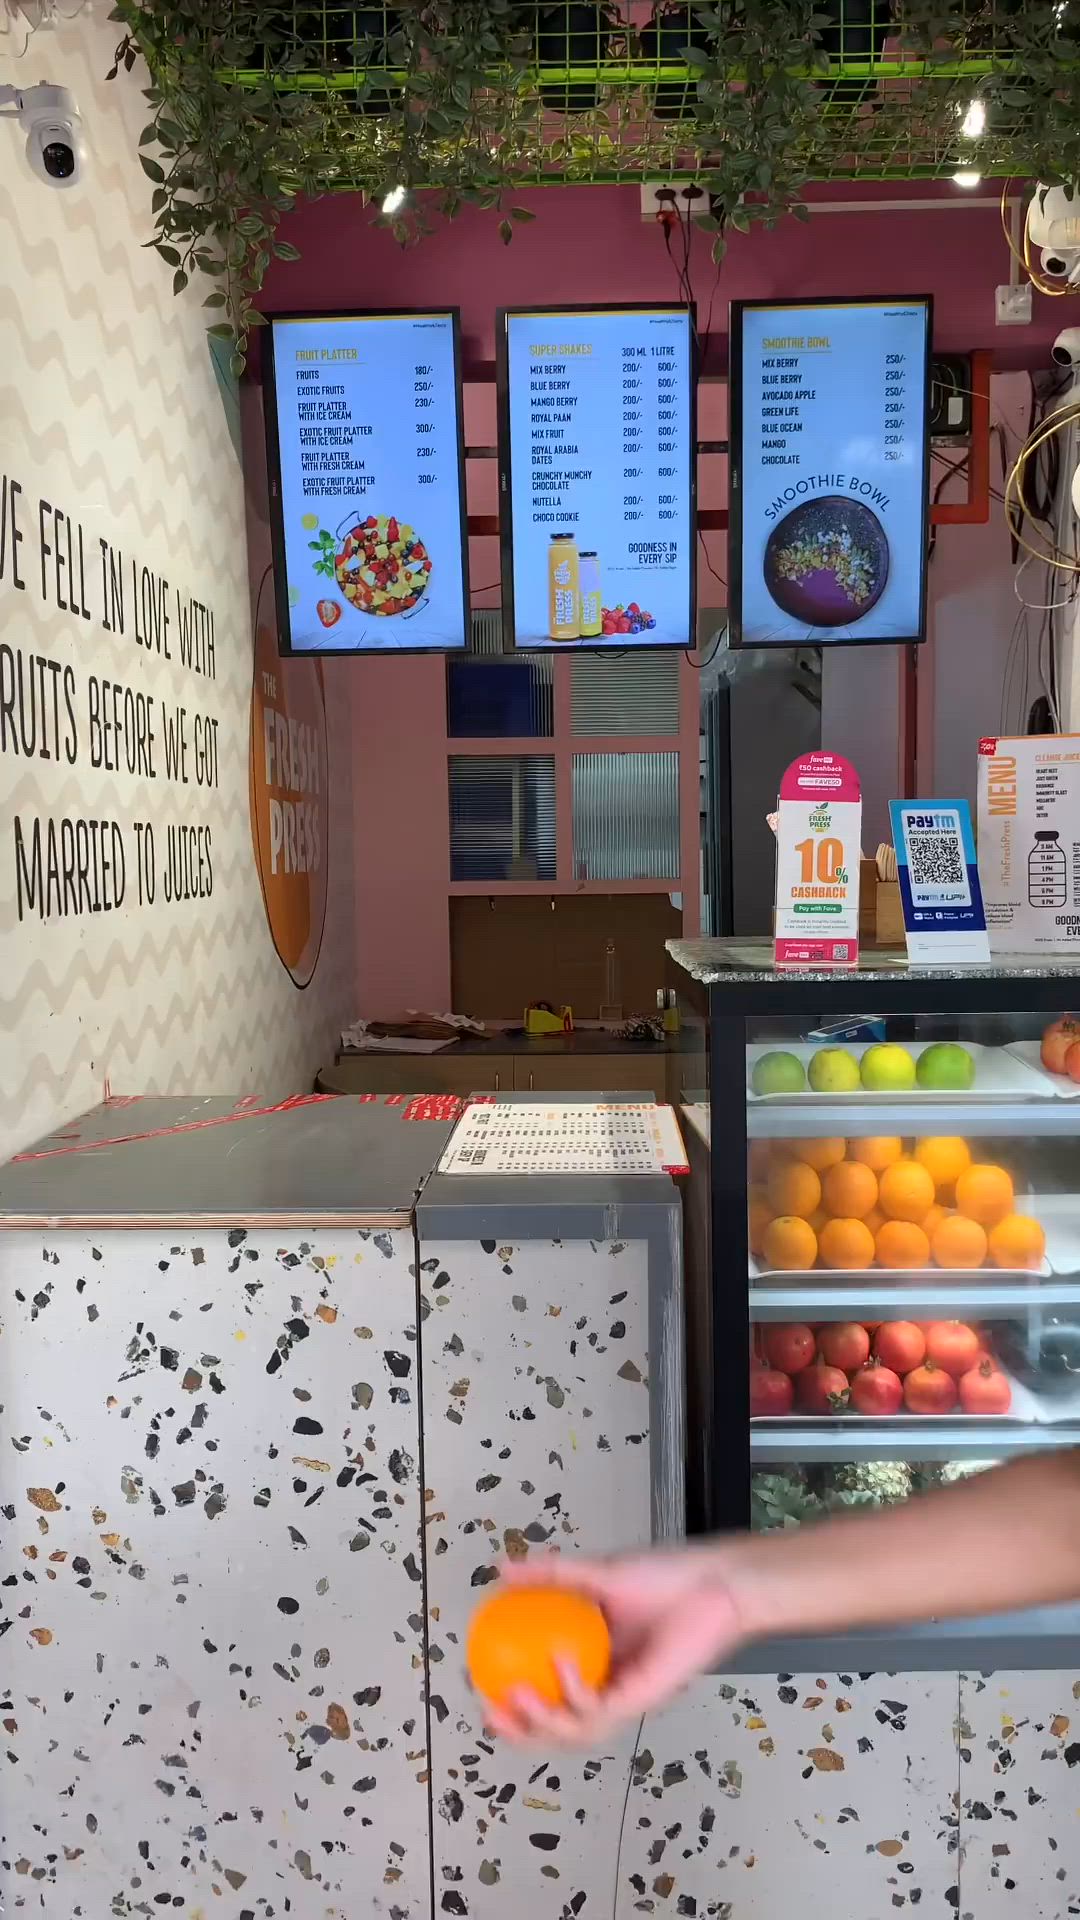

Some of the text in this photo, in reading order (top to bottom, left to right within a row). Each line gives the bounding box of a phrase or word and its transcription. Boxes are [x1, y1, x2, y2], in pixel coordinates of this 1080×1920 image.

[762, 337, 830, 349] SMOOTHIE BOWL
[529, 344, 592, 356] SUPER SHAKES
[622, 347, 647, 356] 300 ML
[652, 347, 675, 356] 1 LITRE
[296, 349, 357, 361] FRUIT PLATTER
[885, 355, 906, 364] 250/-
[623, 364, 642, 372] 200/-
[658, 363, 677, 371] 600/-
[762, 359, 798, 368] MIX BERRY
[415, 366, 433, 375] 180/-
[530, 365, 566, 375] MIX BERRY
[296, 371, 319, 379] FRUITS
[762, 375, 802, 384] BLUE BERRY
[885, 371, 905, 380] 250/-
[414, 383, 433, 391] 250/-
[531, 381, 570, 390] BLUE BERRY
[623, 380, 642, 388] 200/-
[658, 379, 677, 387] 600/-
[297, 386, 344, 396] EXOTIC FRUITS
[885, 388, 905, 396] 250/-
[623, 396, 642, 405] 200/-
[658, 395, 677, 404] 600/-
[762, 391, 815, 401] AVOCADO APPLE
[415, 398, 435, 407] 230/-
[531, 397, 578, 406] MANGO BERRY
[298, 402, 346, 412] FRUIT PLATTER
[885, 404, 905, 413] 250/-
[299, 411, 351, 421] WITH ICE CREAM
[623, 412, 643, 421] 200/-
[658, 411, 677, 420] 600/-
[762, 407, 799, 417] GREEN LIFE
[531, 413, 571, 423] ROYAL PAAN
[416, 424, 435, 433] 300/-
[762, 423, 802, 433] BLUE OCEAN
[885, 420, 905, 429] 250/-
[300, 426, 372, 437] EXOTIC FRUIT PLATTER
[532, 429, 564, 439] MIX FRUIT
[623, 428, 643, 437] 200/-
[658, 427, 677, 436] 600/-
[300, 436, 353, 446] WITH ICE CREAM
[762, 440, 786, 449] MANGO
[532, 446, 578, 455] ROYAL ARABIA
[624, 444, 643, 453] 200/-
[658, 443, 678, 452] 600/-
[301, 452, 349, 462] FRUIT PLATTER
[417, 449, 436, 457] 230/-
[532, 456, 552, 464] DATES
[762, 455, 800, 464] CHOCOLATE
[302, 461, 365, 471] WITH FRESH CREAM
[532, 471, 592, 481] CRUNCHY MUNCHY
[624, 468, 643, 477] 200/-
[659, 468, 678, 477] 600/-
[303, 477, 375, 487] EXOTIC FRUIT PLATTER
[418, 475, 437, 483] 300/-
[532, 481, 569, 490] CHOCOLATE
[303, 486, 366, 496] WITH FRESH CREAM
[624, 496, 643, 505] 200/-
[659, 496, 678, 504] 600/-
[765, 474, 845, 520] SMOOTHIE
[849, 477, 890, 512] BOWL
[533, 498, 561, 506] NUTELLA
[533, 513, 579, 522] CHOCO COOKIE
[624, 512, 644, 521] 200/-
[659, 511, 678, 520] 600/-
[628, 542, 677, 553] GOODNESS IN
[639, 554, 676, 564] EVERY SIP
[0, 474, 216, 680] E FELL IN LOVE WITH
[262, 671, 277, 700] THE
[88, 674, 156, 779] BEFORE
[162, 701, 189, 785] WE
[194, 719, 219, 788] GOT
[263, 707, 319, 794] FRESH
[988, 756, 1016, 815] MENU
[269, 798, 320, 875] PRESS
[794, 838, 848, 884] 10%
[14, 815, 213, 922] MARRIED TO JUICES
[791, 887, 846, 898] CASHBACK
